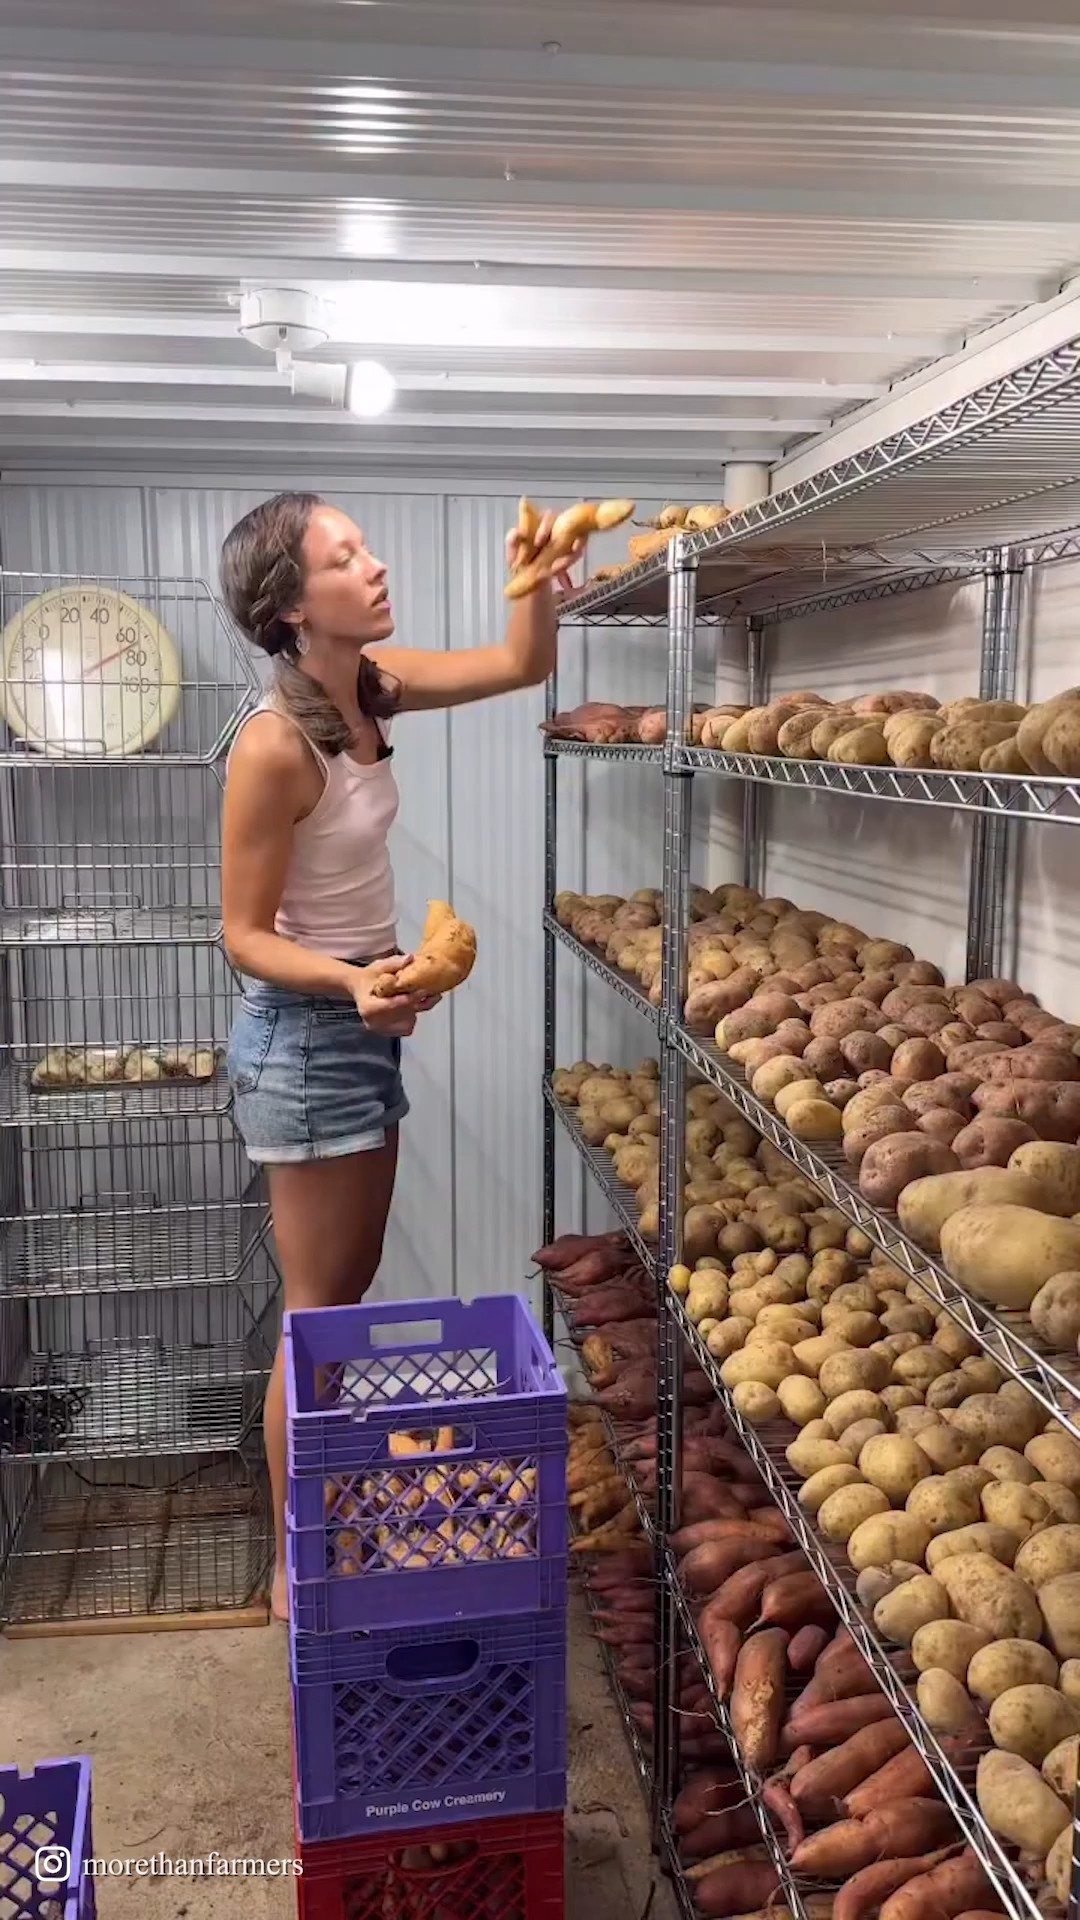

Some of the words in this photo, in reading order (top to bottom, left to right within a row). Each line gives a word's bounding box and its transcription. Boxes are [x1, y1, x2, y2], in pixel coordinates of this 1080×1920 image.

[61, 607, 80, 623] 20
[90, 608, 110, 624] 40
[39, 625, 50, 641] 0
[116, 627, 136, 643] 60
[126, 650, 147, 666] 80
[365, 1802, 409, 1818] Purple
[412, 1799, 441, 1812] Cow
[444, 1789, 507, 1808] Creamery
